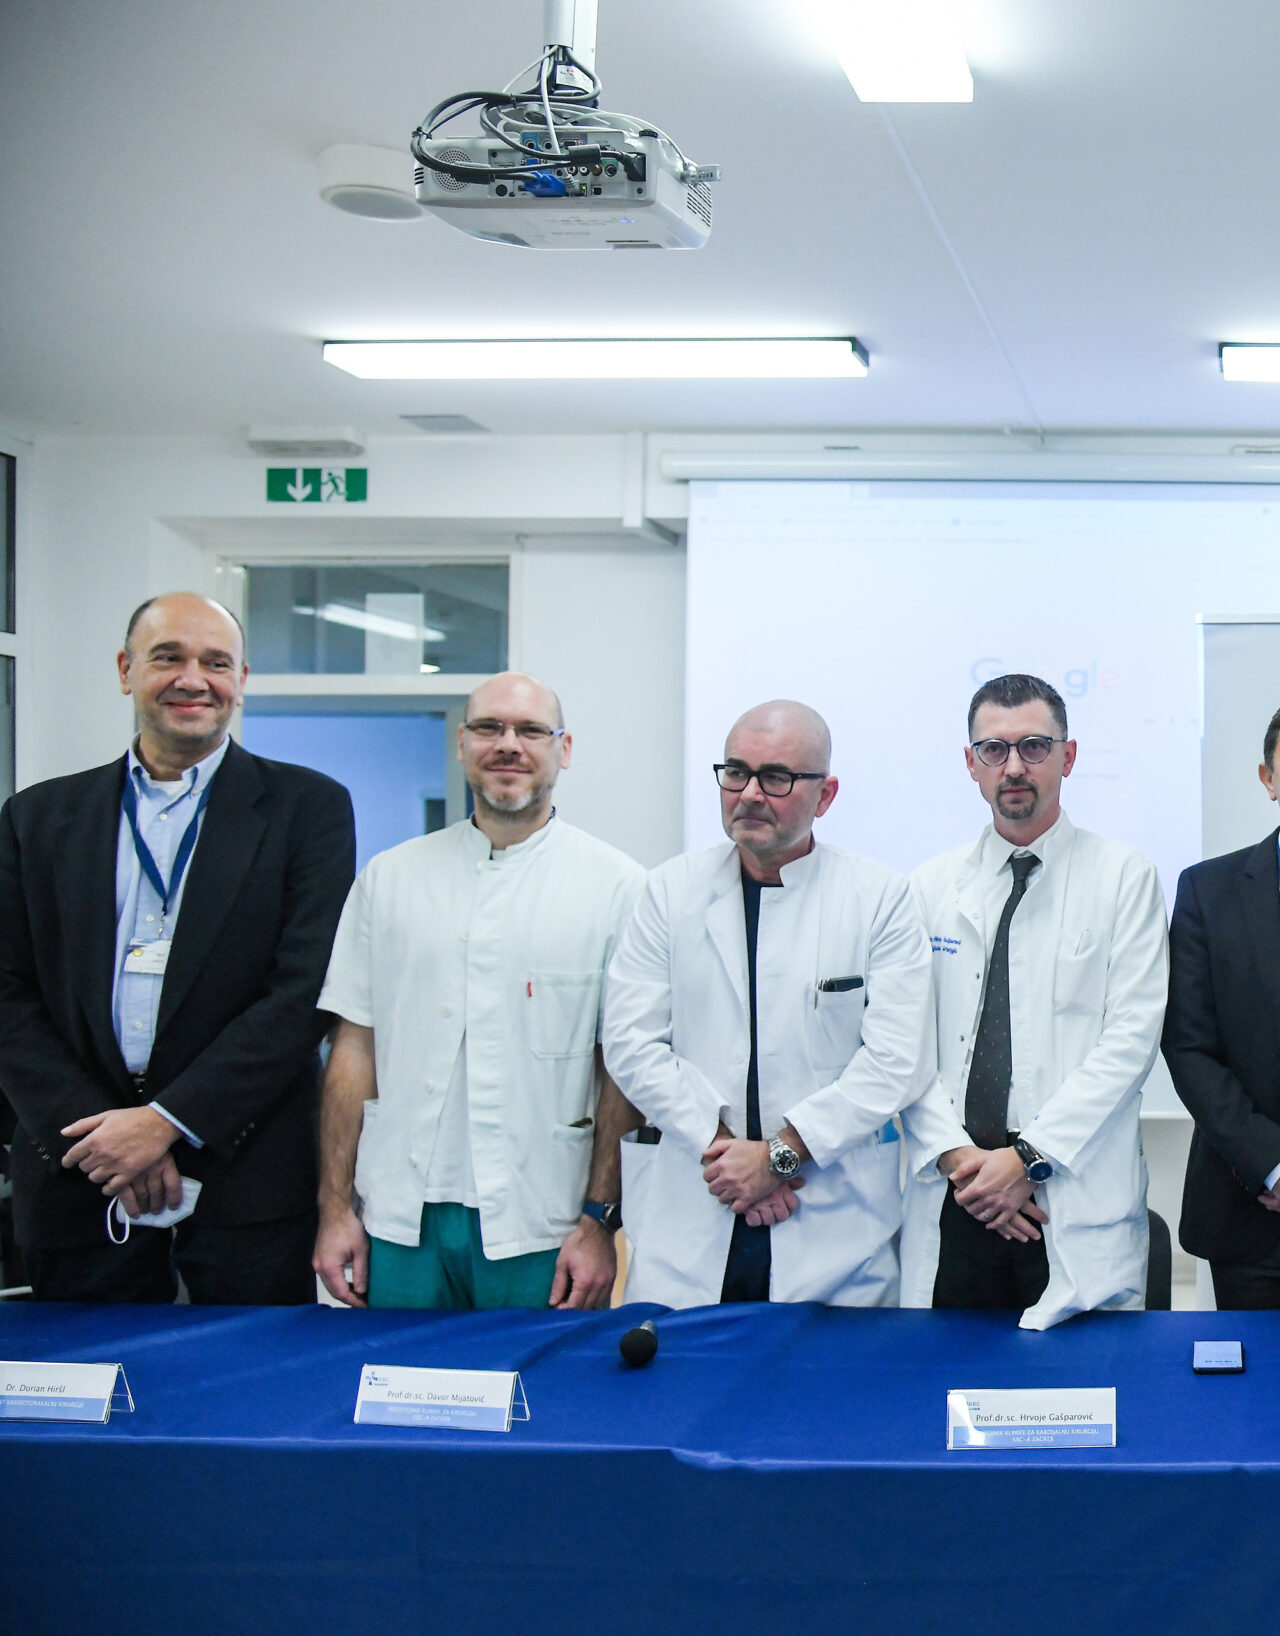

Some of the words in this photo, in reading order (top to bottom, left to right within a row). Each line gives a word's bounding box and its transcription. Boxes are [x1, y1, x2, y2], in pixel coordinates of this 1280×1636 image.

[970, 657, 1121, 698] Gogle
[20, 1384, 45, 1392] Dorian
[47, 1385, 66, 1393] Hiršl
[427, 1392, 449, 1400] Davor
[452, 1393, 485, 1403] Mijatović
[976, 1414, 1017, 1422] Prof.dr.sc.
[1020, 1413, 1046, 1422] Hrvoje
[1049, 1412, 1093, 1422] Gašparović
